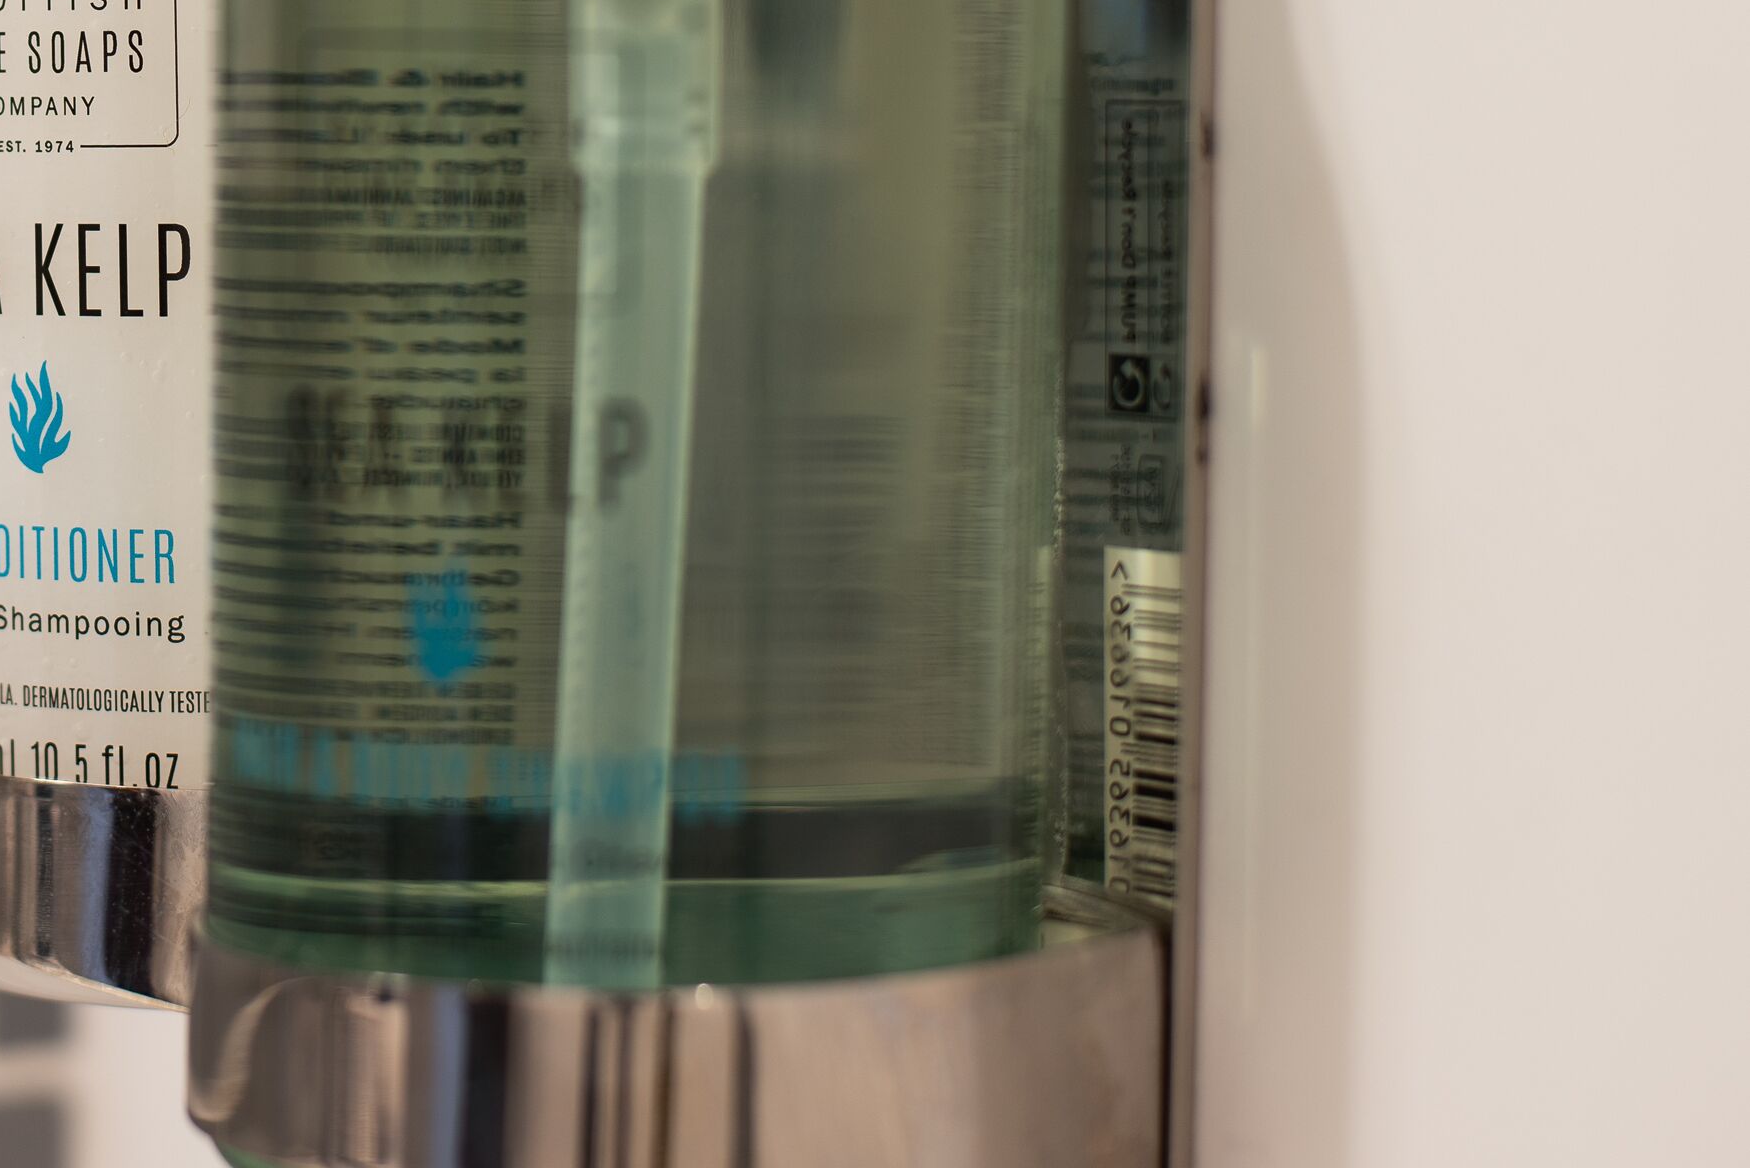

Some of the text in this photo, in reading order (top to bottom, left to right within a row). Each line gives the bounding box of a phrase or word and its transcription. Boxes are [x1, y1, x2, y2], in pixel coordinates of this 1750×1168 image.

[27, 29, 144, 74] SOAPS
[35, 141, 74, 153] 1974
[34, 223, 191, 317] KELP
[23, 685, 165, 713] DERMATOLOGICALLY
[169, 689, 211, 713] TESTE
[31, 741, 89, 783] 105
